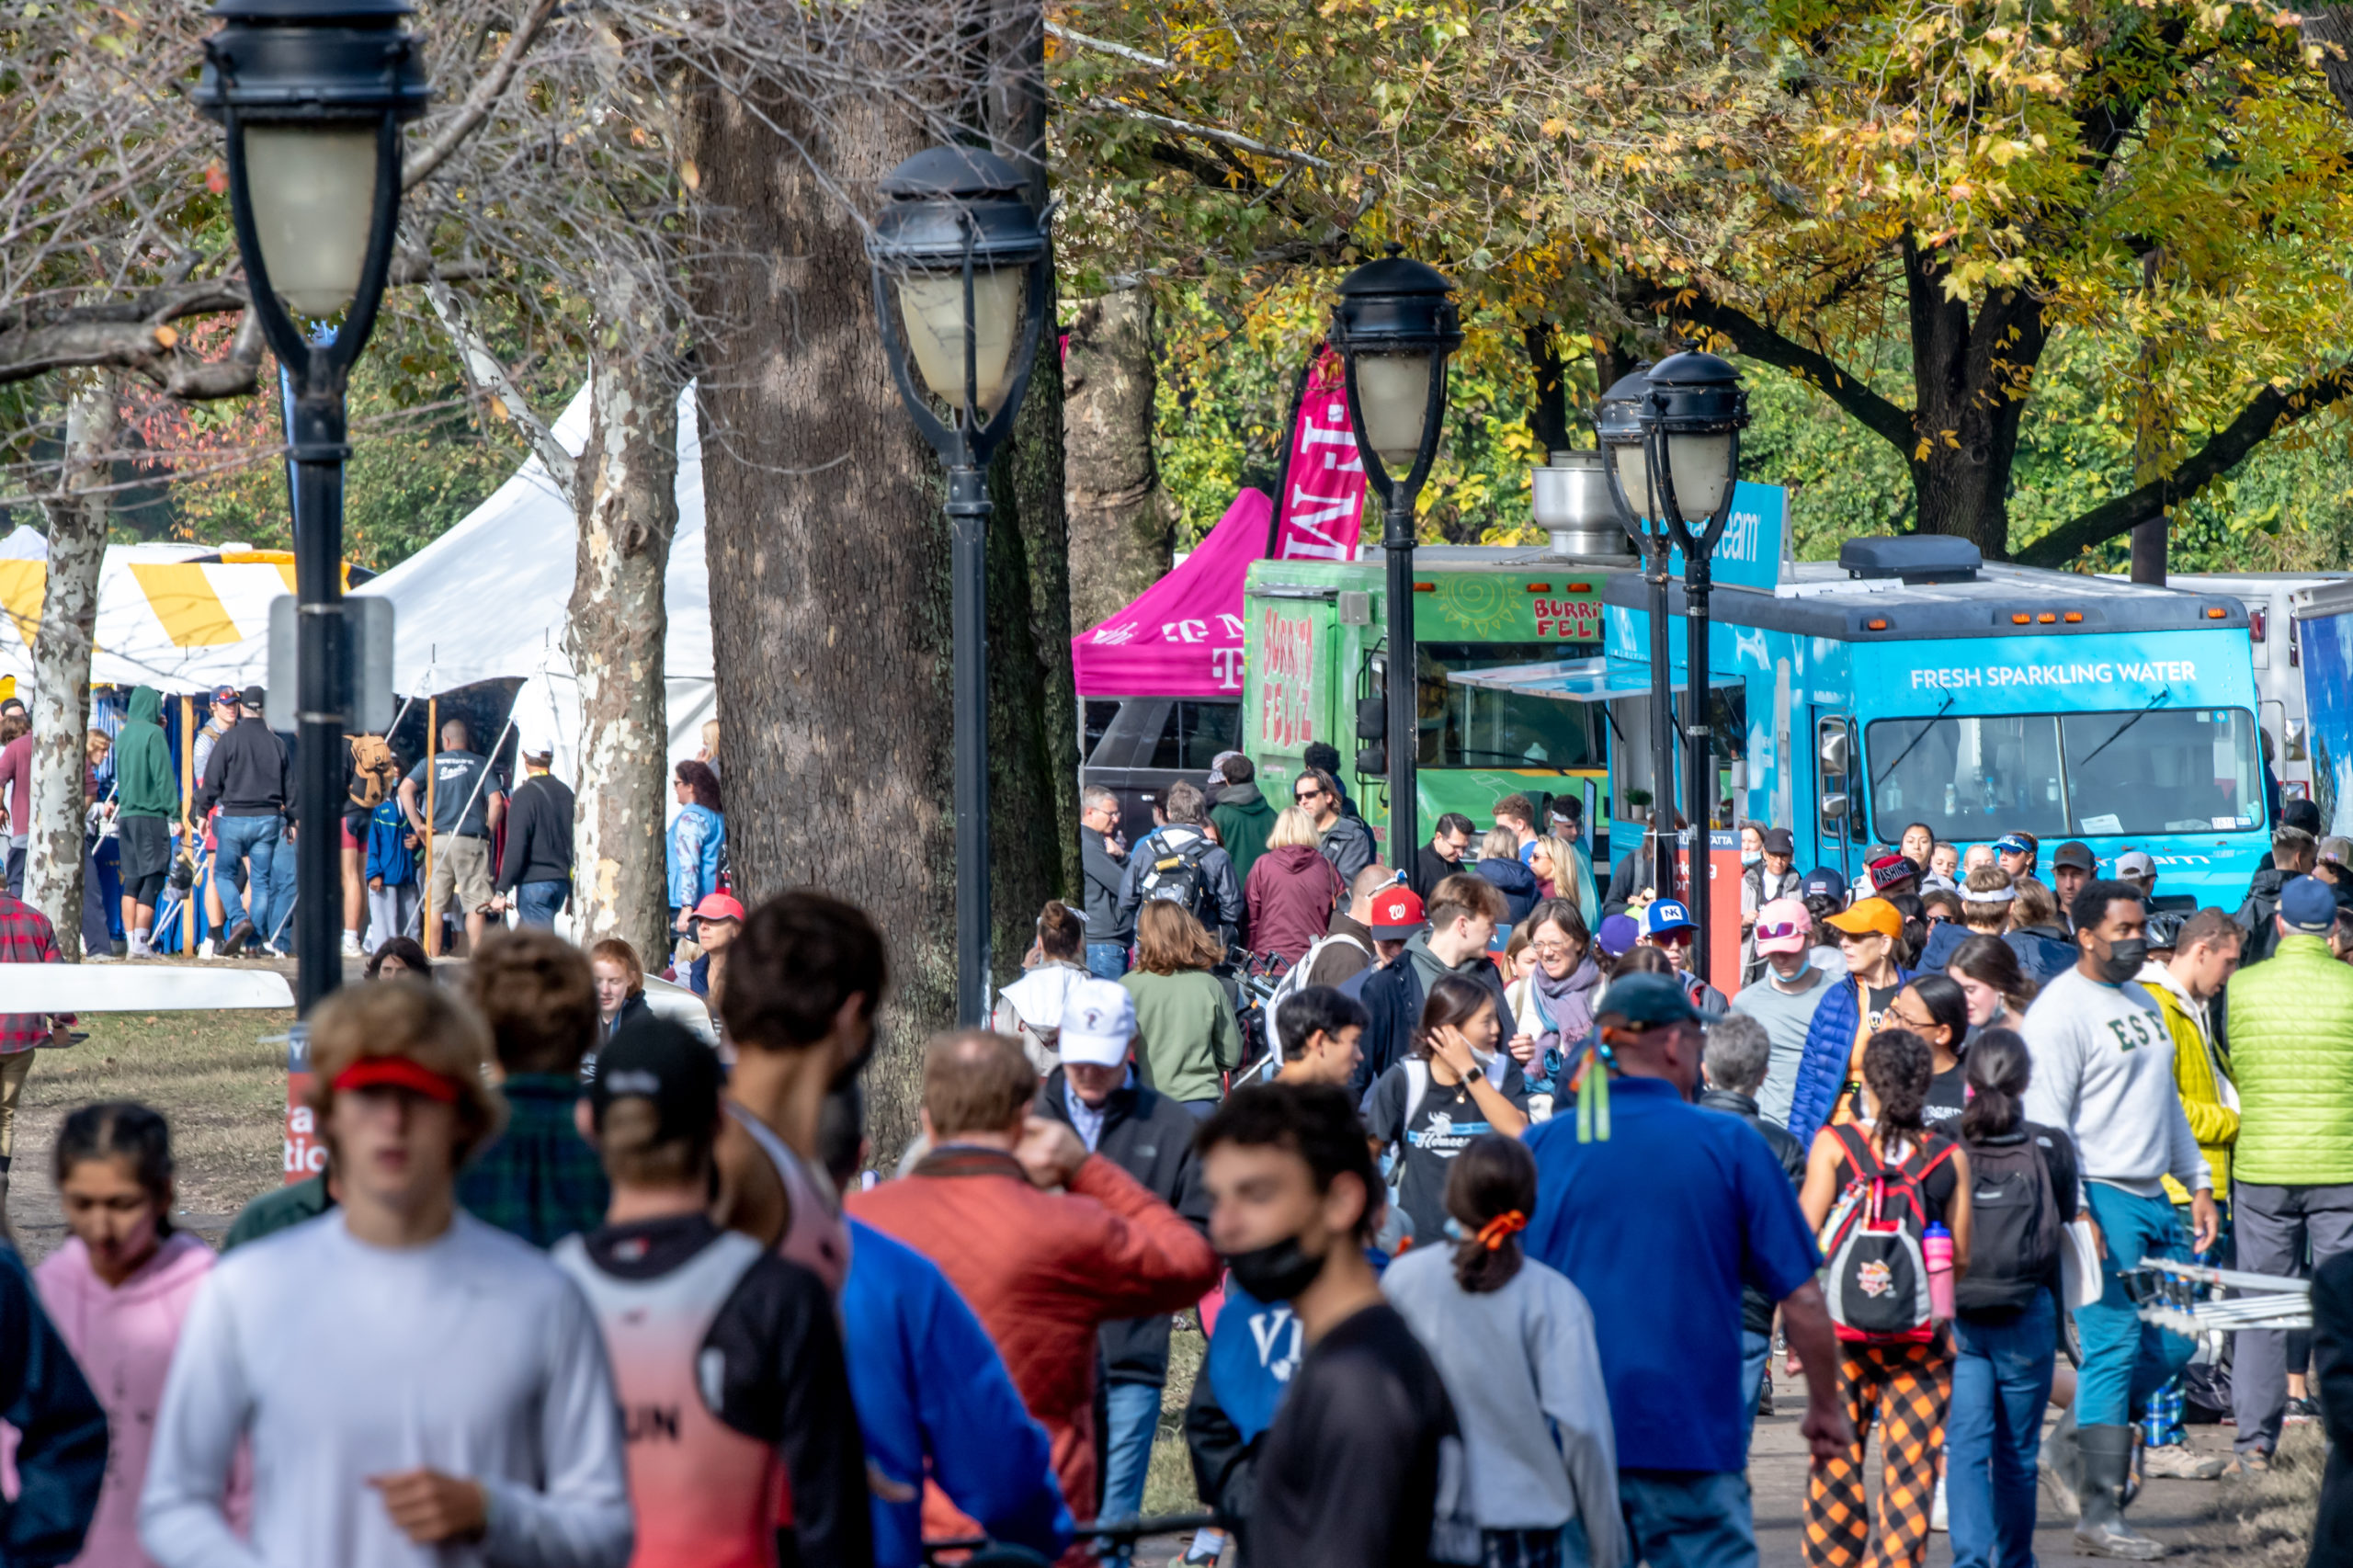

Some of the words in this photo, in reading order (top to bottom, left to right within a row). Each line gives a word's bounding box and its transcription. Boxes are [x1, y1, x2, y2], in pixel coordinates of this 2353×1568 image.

[1911, 668, 1982, 689] FRESH
[1987, 665, 2113, 687] SPARKLING
[2118, 661, 2198, 682] WATER
[1711, 835, 1733, 846] ATTA
[1664, 908, 1679, 918] NK
